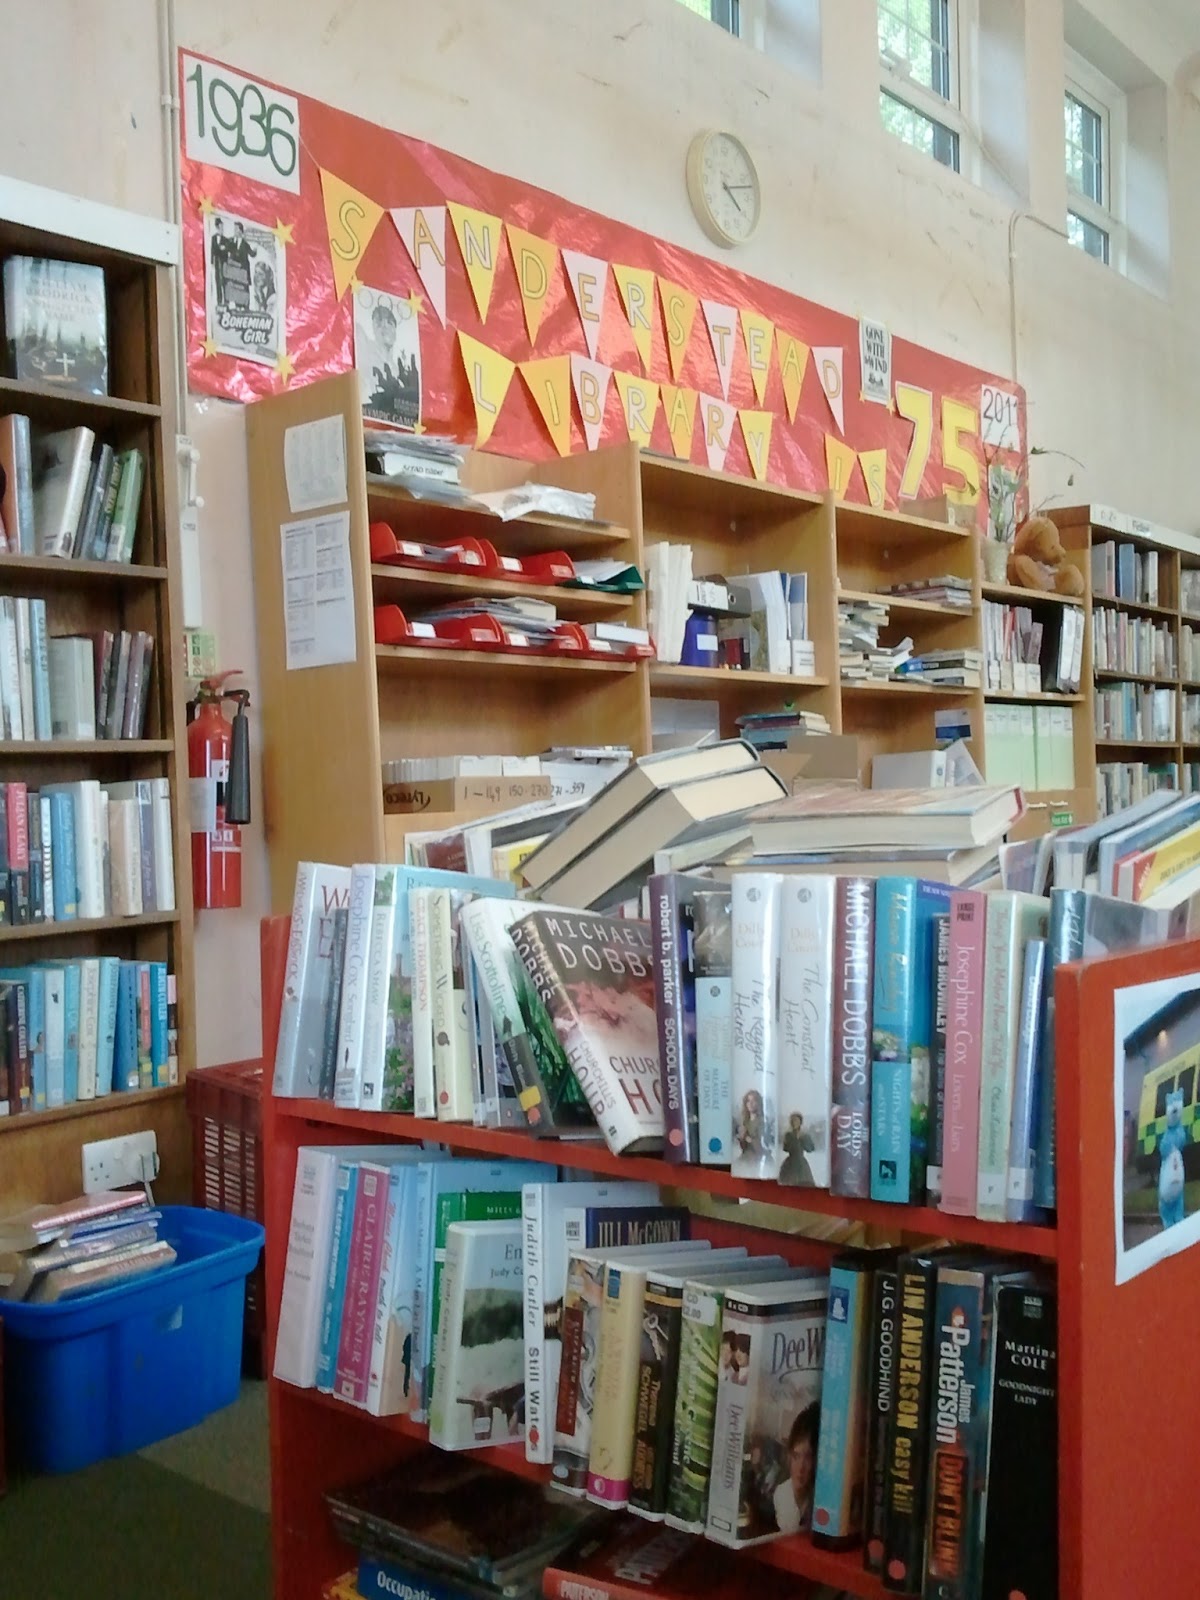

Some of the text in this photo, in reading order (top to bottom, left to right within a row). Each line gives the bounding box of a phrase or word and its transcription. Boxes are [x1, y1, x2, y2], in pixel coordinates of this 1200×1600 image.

[187, 64, 296, 176] 1936
[221, 312, 273, 330] BOHEMIAN
[243, 329, 268, 344] GIRL
[865, 326, 884, 343] GONE
[866, 340, 885, 358] WITH
[869, 357, 887, 374] WIND
[363, 408, 391, 421] LYMPIC
[895, 381, 980, 506] 75
[348, 873, 369, 988] Josephine Cox
[372, 913, 386, 966] REBECCA
[433, 894, 446, 973] SOMETHING
[545, 917, 653, 948] MICHAEL
[660, 894, 672, 937] robert
[418, 942, 428, 1011] THOMPSON
[469, 911, 507, 1015] Lisa Scottoline
[510, 928, 552, 1003] DOBBS
[522, 920, 563, 997] MICHAEL
[661, 958, 674, 1006] parker
[841, 885, 871, 1087] MICHAEL DOBBS
[734, 991, 751, 1050] Heiress
[783, 998, 800, 1056] Heart
[800, 963, 822, 1080] The Constant
[936, 965, 948, 1034] BROWNLEY
[951, 943, 975, 1065] Josephine Cox
[608, 1056, 660, 1075] CHUR
[664, 1017, 679, 1110] SCHOOL DAYS
[951, 1073, 965, 1111] Lovers
[837, 1114, 852, 1153] DAY
[627, 1220, 681, 1247] McGOWN
[351, 1203, 377, 1364] CLAIRE RAYNER
[524, 1215, 542, 1452] Judith Cutler Still Wats
[1004, 1340, 1056, 1360] Martina
[1010, 1353, 1047, 1371] COLE
[877, 1318, 894, 1412] GOODHIND
[892, 1274, 926, 1515] LIN ANDERSON easy kill
[935, 1324, 971, 1444] Patterson
[637, 1365, 652, 1434] SCHWEGEL
[957, 1378, 976, 1424] James
[1014, 1393, 1038, 1406] LADY
